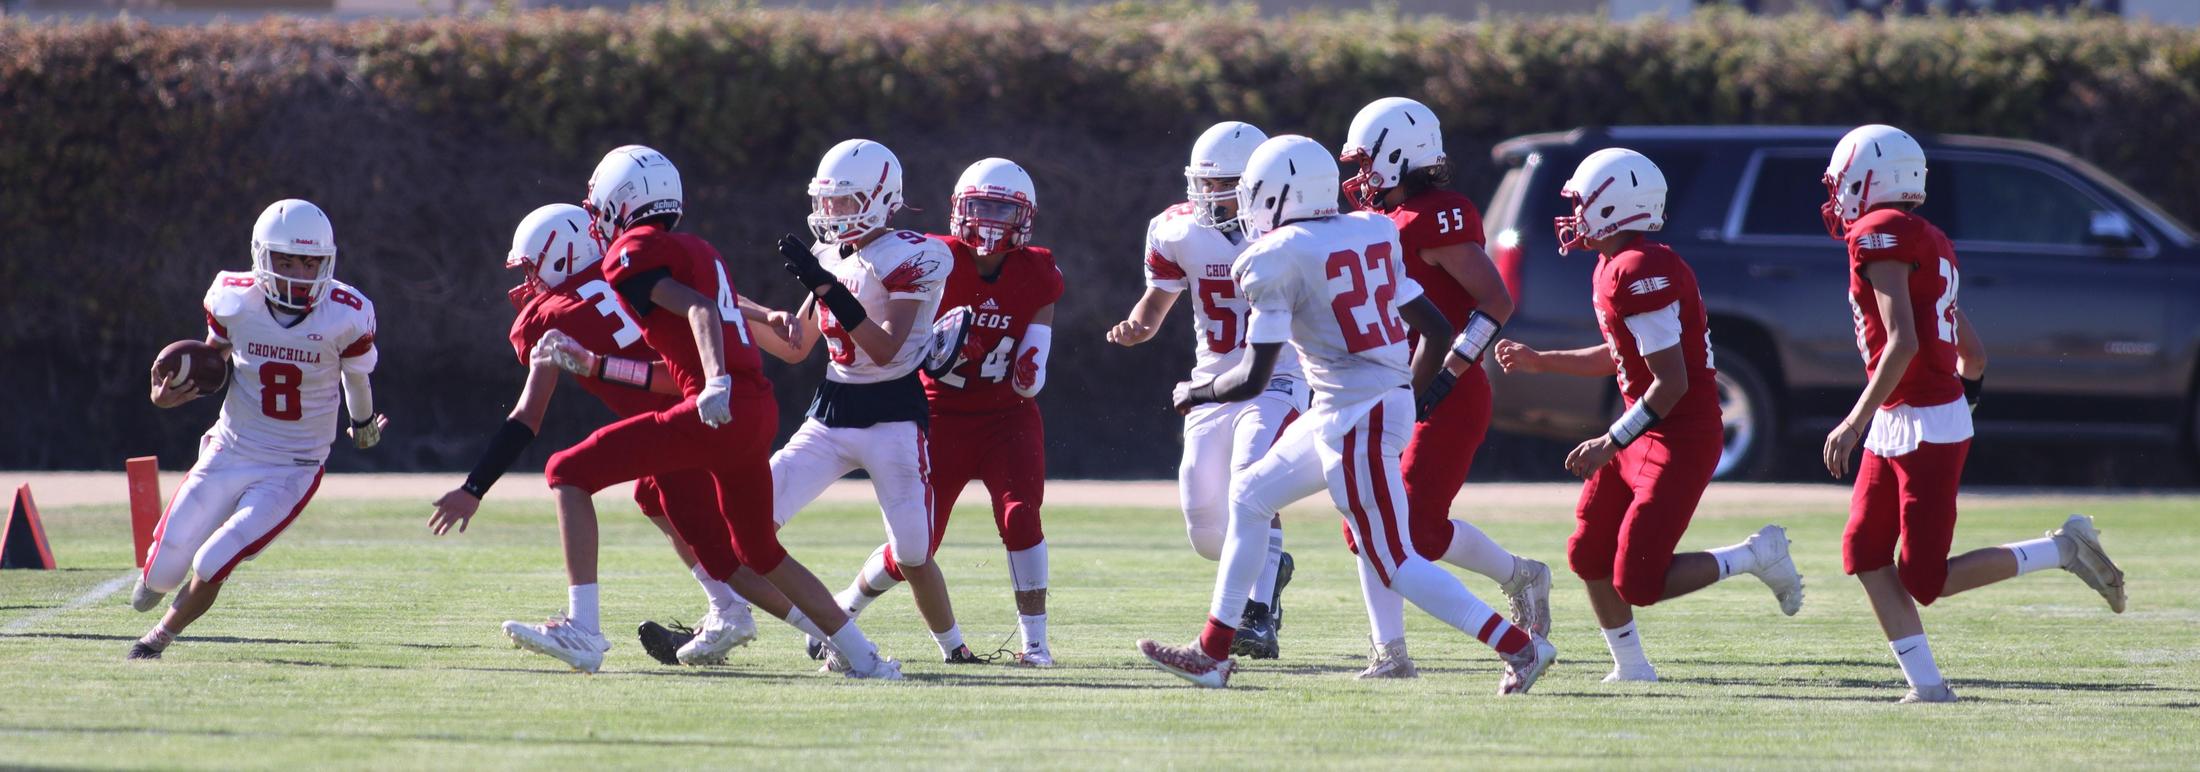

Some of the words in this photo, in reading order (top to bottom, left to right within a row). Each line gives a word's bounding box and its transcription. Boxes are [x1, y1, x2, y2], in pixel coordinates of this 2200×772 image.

[1437, 208, 1463, 234] 55
[896, 231, 927, 244] 9
[619, 247, 630, 267] 4
[330, 288, 362, 310] 8
[715, 259, 749, 345] 4
[1325, 242, 1406, 353] 22
[1199, 277, 1252, 354] 5
[248, 342, 321, 364] CHOWCHILLA
[259, 361, 303, 421] 8
